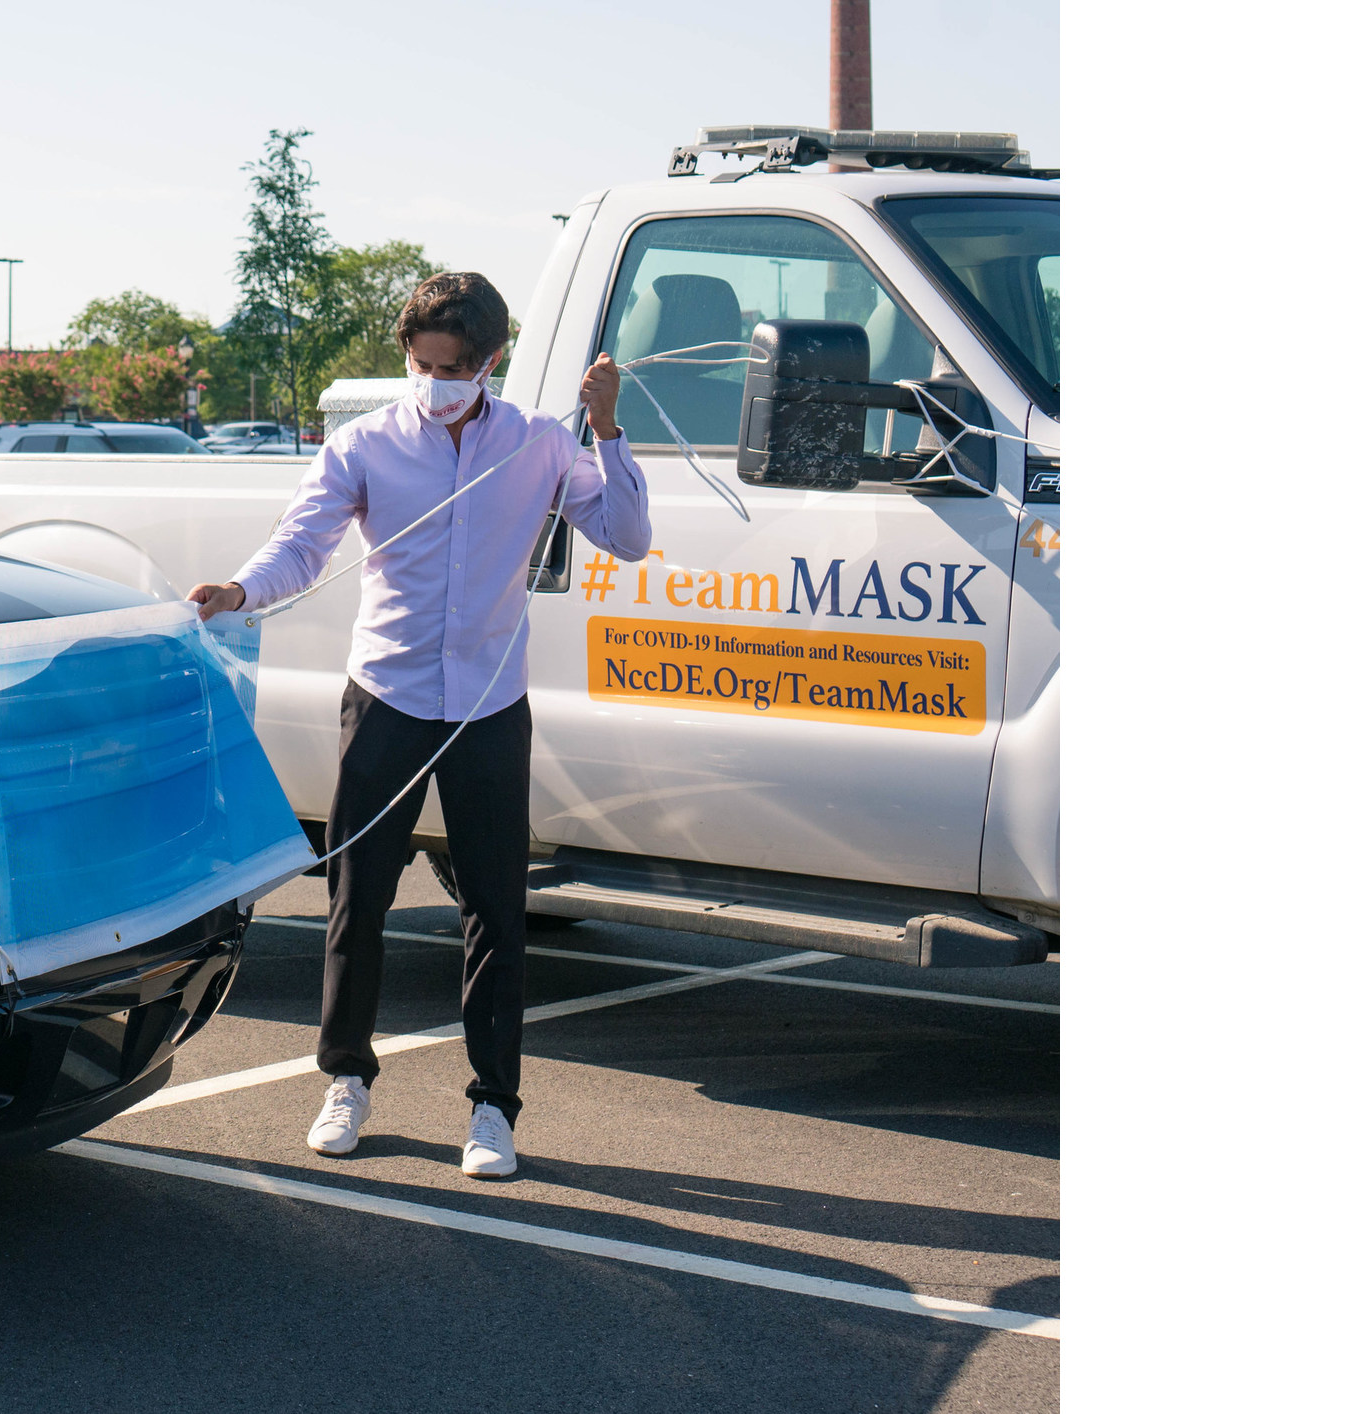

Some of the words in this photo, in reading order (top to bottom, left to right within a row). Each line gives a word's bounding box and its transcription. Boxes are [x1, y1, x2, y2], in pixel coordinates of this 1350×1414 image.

[581, 550, 986, 626] #TeamMASK
[604, 628, 629, 646] For
[633, 630, 710, 652] COVID-19
[714, 636, 804, 658] Information
[808, 644, 837, 661] and
[842, 645, 922, 668] Resources
[927, 650, 970, 670] Visit:
[605, 658, 968, 719] NccDE.Org/TeamMask
